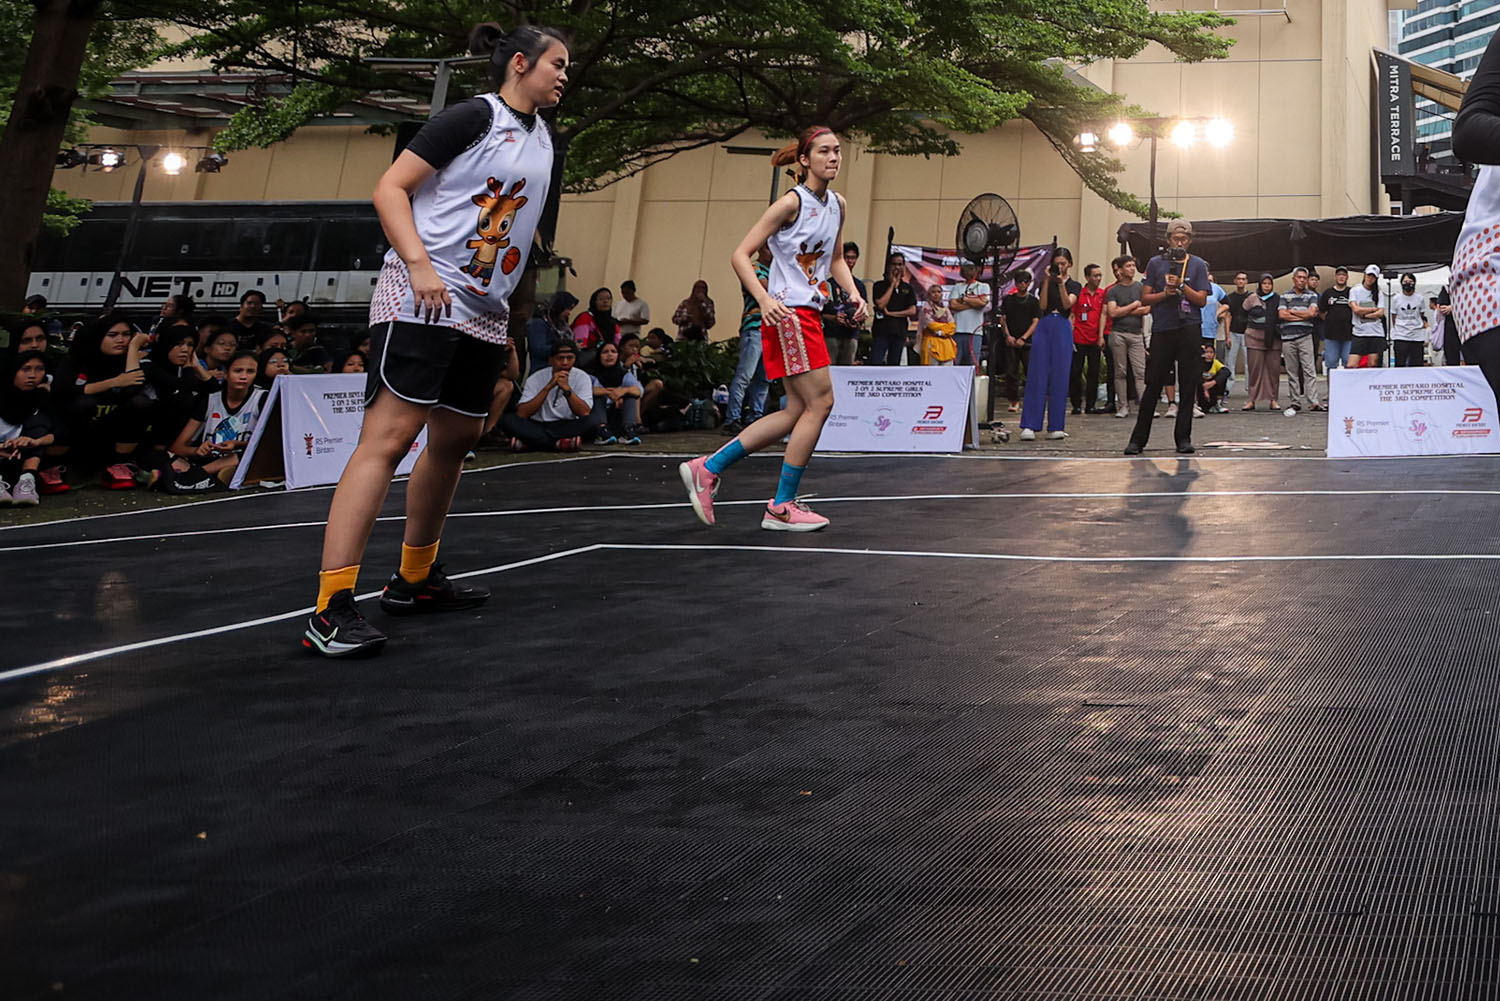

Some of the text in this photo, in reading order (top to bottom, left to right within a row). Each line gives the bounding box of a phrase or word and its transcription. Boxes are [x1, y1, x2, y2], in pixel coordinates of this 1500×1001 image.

[1389, 65, 1401, 161] MITRA TERRACE
[120, 277, 236, 298] NET. HD
